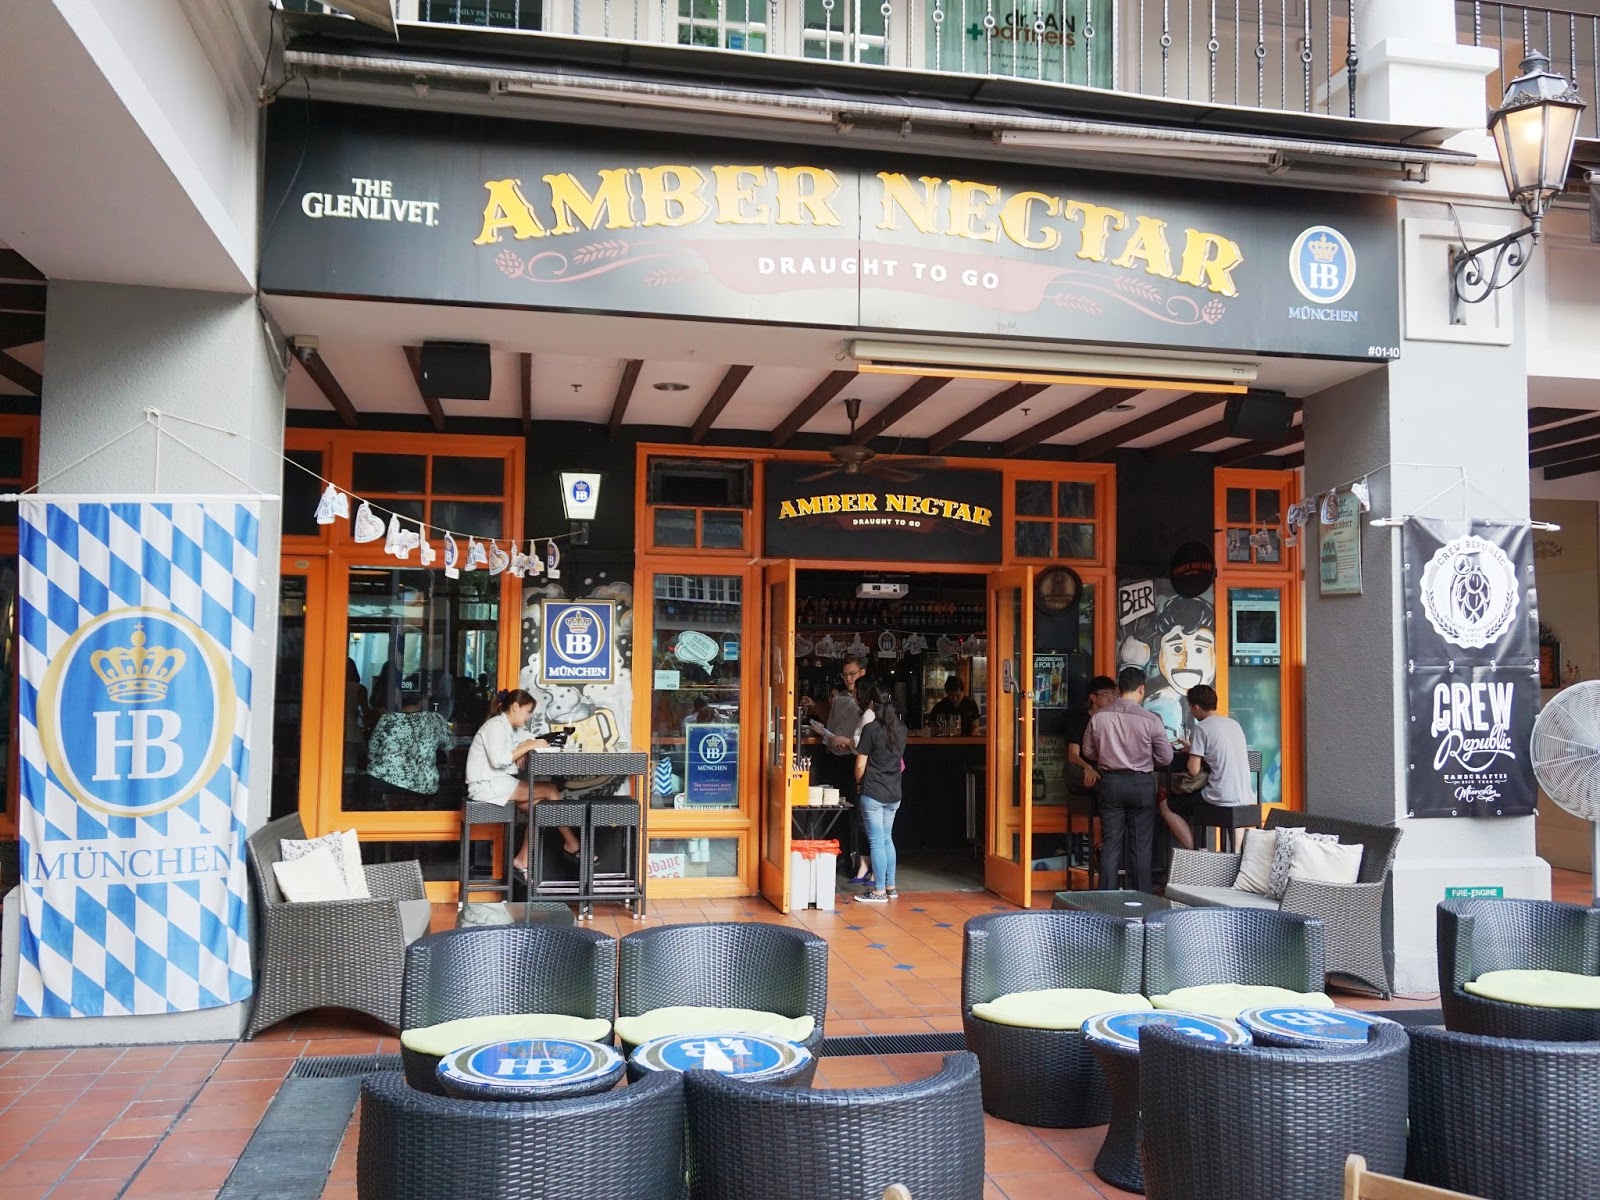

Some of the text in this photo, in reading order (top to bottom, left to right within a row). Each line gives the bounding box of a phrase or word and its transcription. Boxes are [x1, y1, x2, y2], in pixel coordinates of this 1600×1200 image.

[351, 177, 393, 198] THE
[301, 191, 440, 227] GLENLIVET.
[473, 165, 1245, 298] AMBER NECTAR
[758, 256, 1000, 291] DRAUGHT TO GO
[1309, 262, 1340, 290] HB
[1288, 305, 1360, 322] MÜNCHEN
[1367, 345, 1400, 357] #01-10
[778, 493, 993, 527] AMBER NECTAR
[852, 518, 892, 526] DRAUGHT
[1437, 544, 1461, 566] CREW
[1466, 540, 1507, 567] REPUBLIC
[1119, 586, 1155, 620] BEER
[565, 633, 592, 654] HB
[686, 640, 709, 657] JESUS
[692, 635, 711, 652] BEER
[548, 666, 607, 677] MÜNCHEN
[1433, 682, 1514, 731] CREW
[92, 709, 184, 782] HB
[706, 747, 720, 759] HB
[1431, 718, 1516, 773] Republic
[33, 842, 235, 881] MÜNCHEN
[494, 1058, 568, 1075] HB
